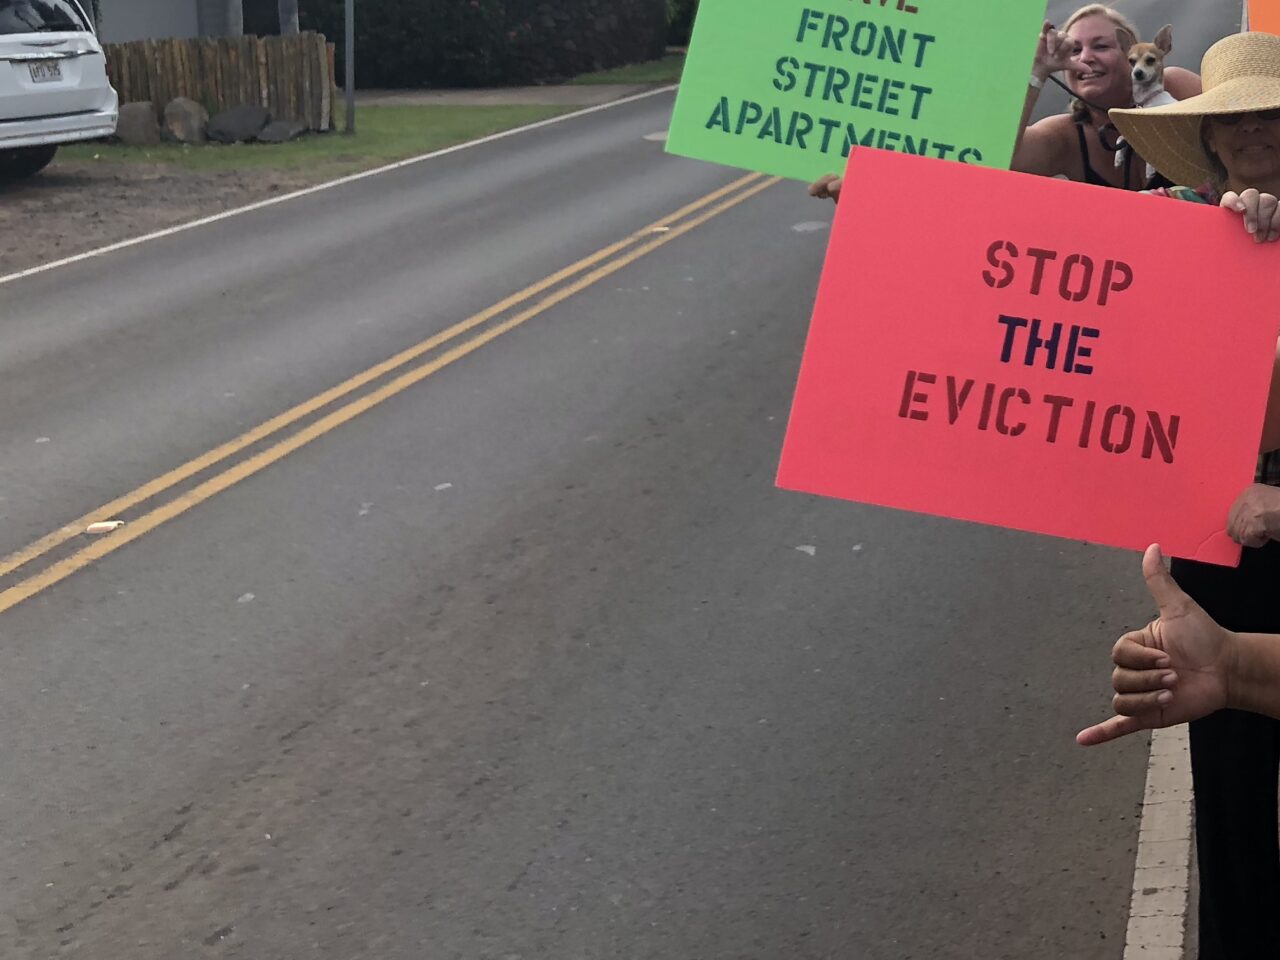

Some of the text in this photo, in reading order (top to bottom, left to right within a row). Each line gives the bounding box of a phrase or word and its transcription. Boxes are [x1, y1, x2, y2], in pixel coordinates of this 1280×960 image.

[795, 8, 936, 68] FRONT
[772, 56, 933, 120] STREET
[982, 240, 1134, 306] STOP
[998, 314, 1100, 375] THE
[899, 370, 1181, 464] EVICTION
